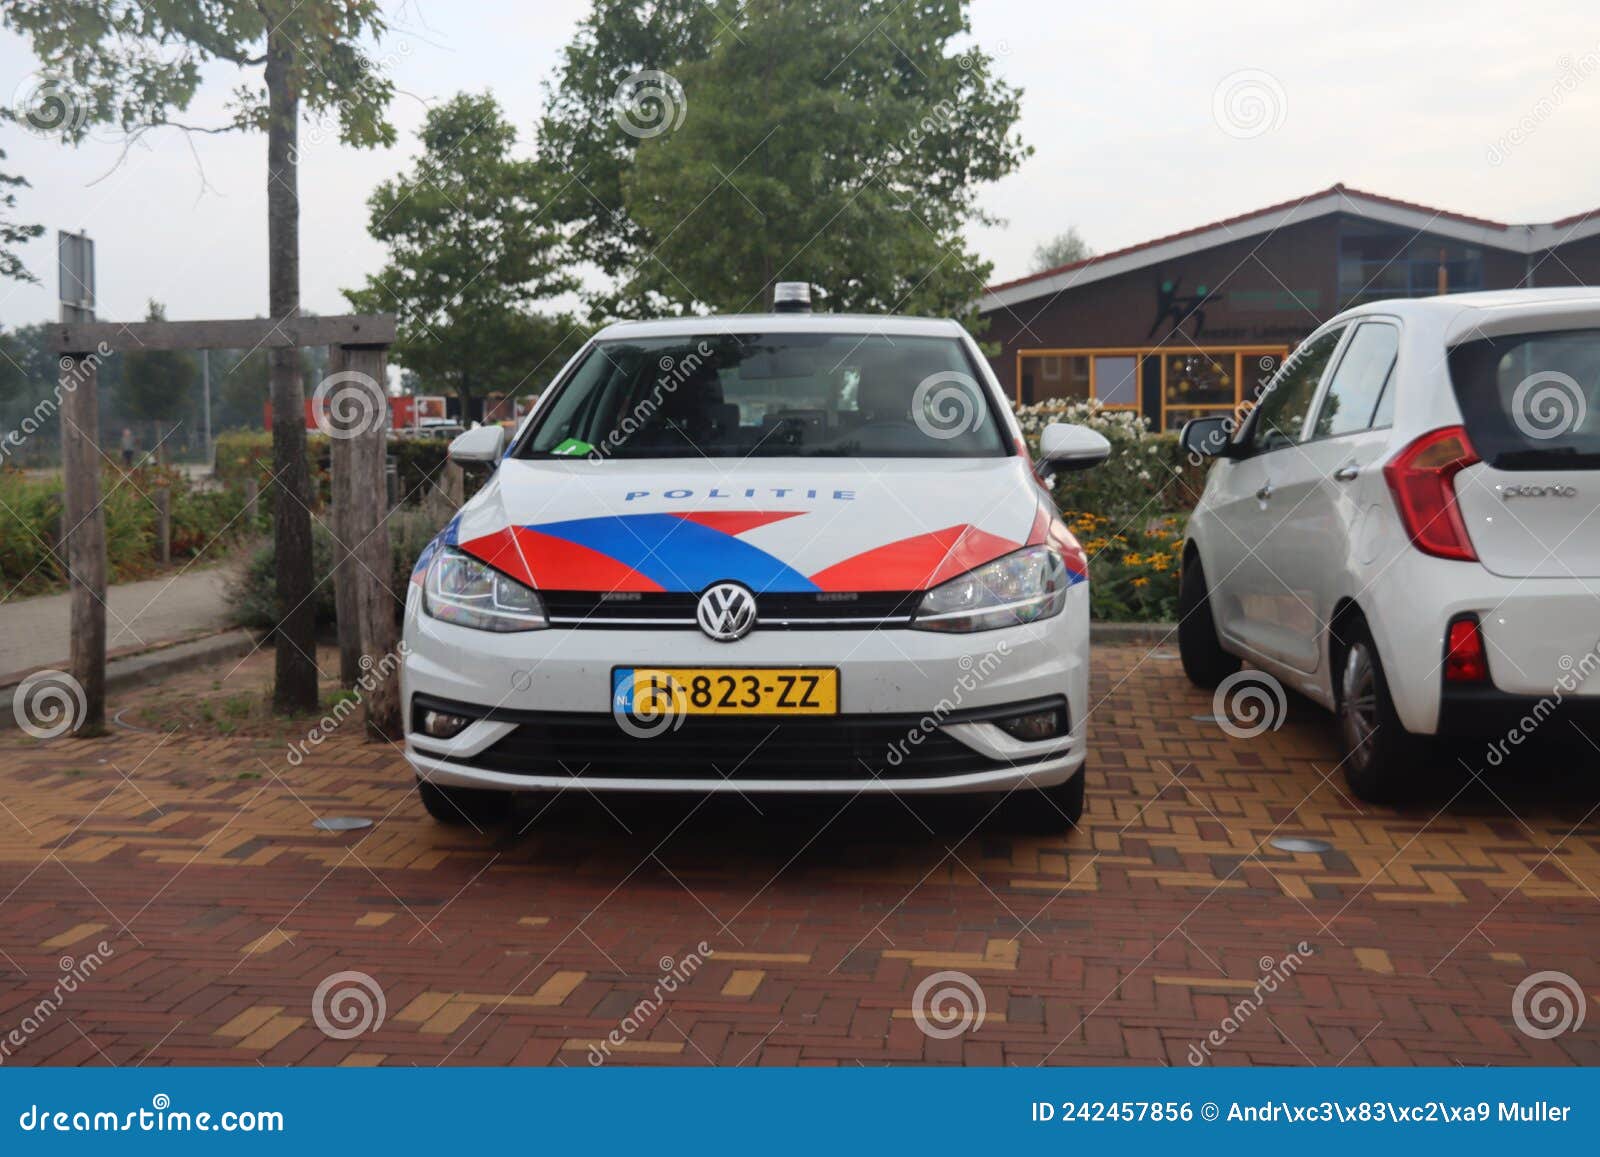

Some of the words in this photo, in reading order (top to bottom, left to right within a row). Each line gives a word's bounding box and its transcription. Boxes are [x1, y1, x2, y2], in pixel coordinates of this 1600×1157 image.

[625, 488, 857, 501] POLITIE
[651, 675, 820, 707] H-823-ZZ
[617, 696, 631, 706] NL
